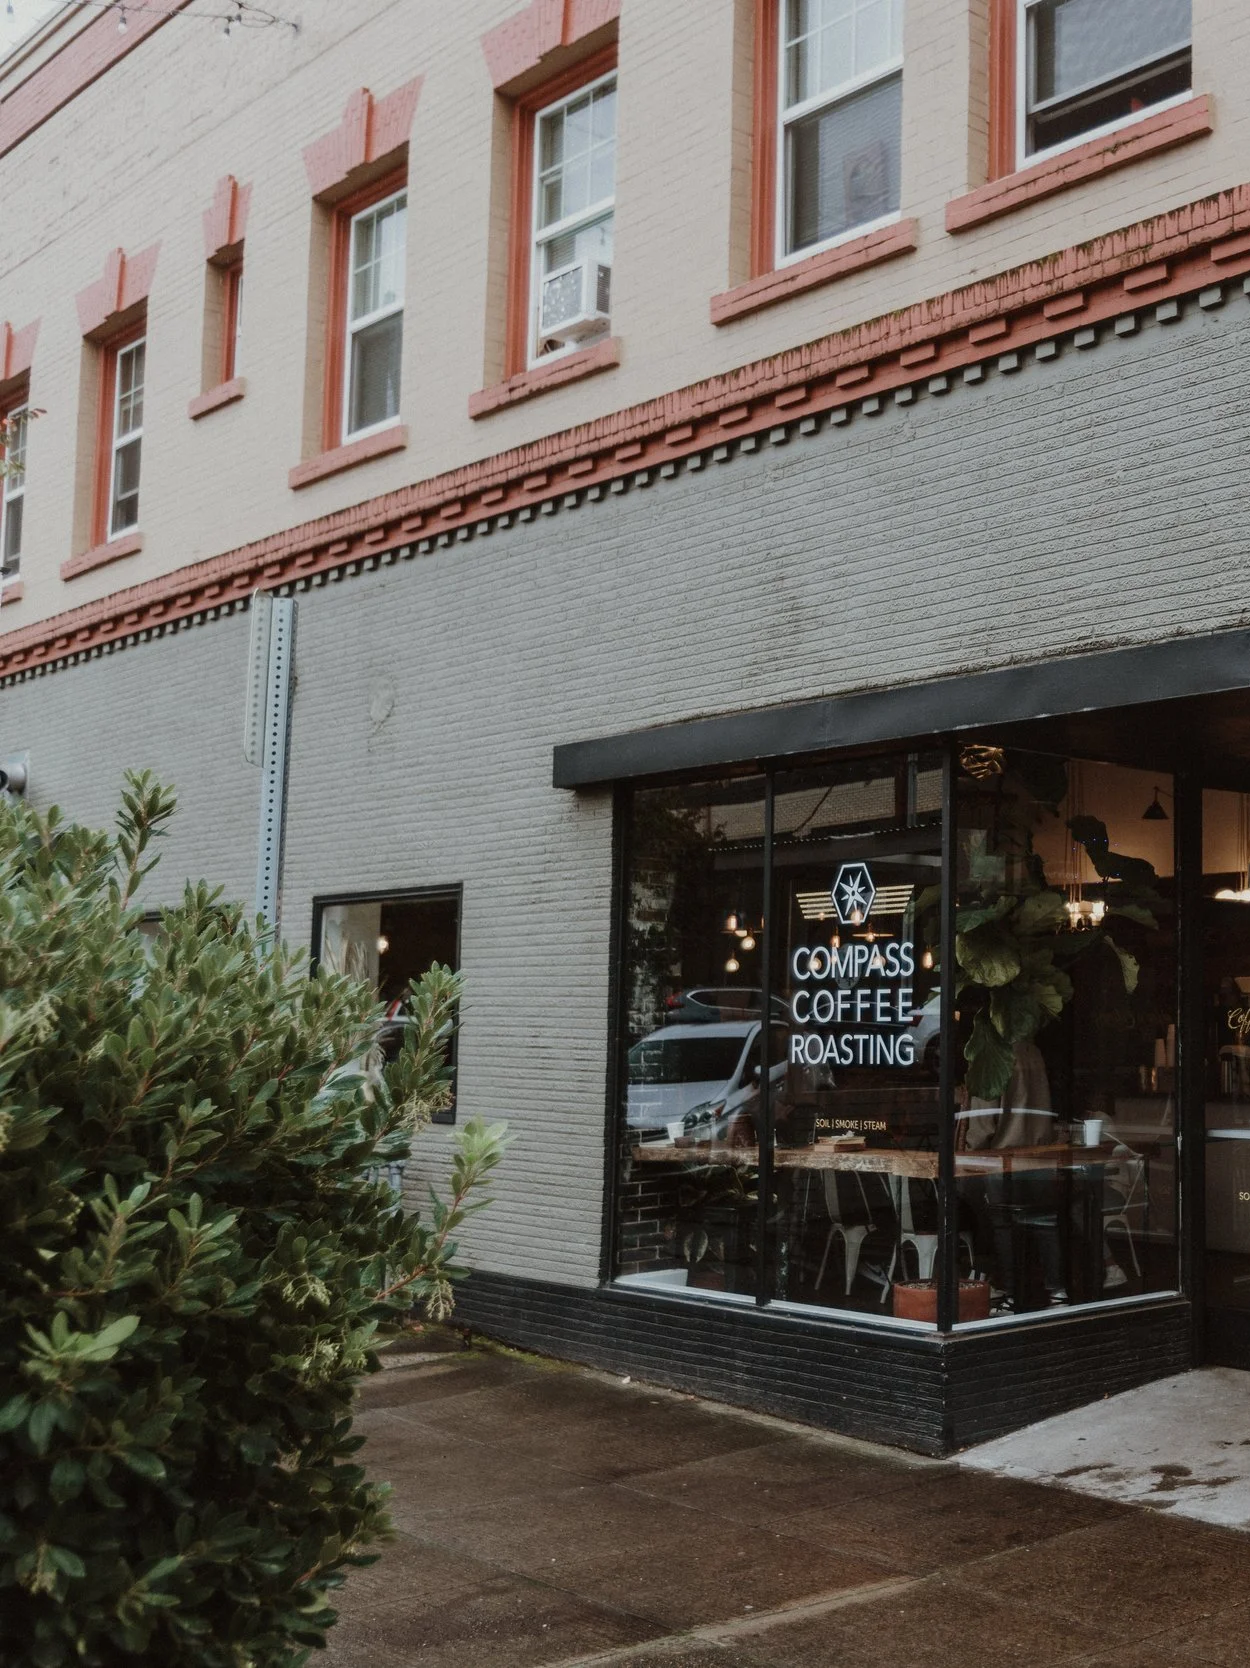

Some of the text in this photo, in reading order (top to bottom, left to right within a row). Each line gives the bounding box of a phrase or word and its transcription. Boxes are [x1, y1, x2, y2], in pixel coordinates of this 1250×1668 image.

[793, 942, 914, 980] COMPASS
[792, 988, 914, 1023] COFFEE
[791, 1033, 915, 1066] ROASTING
[815, 1118, 887, 1131] SOIL SMOKE STEAM
